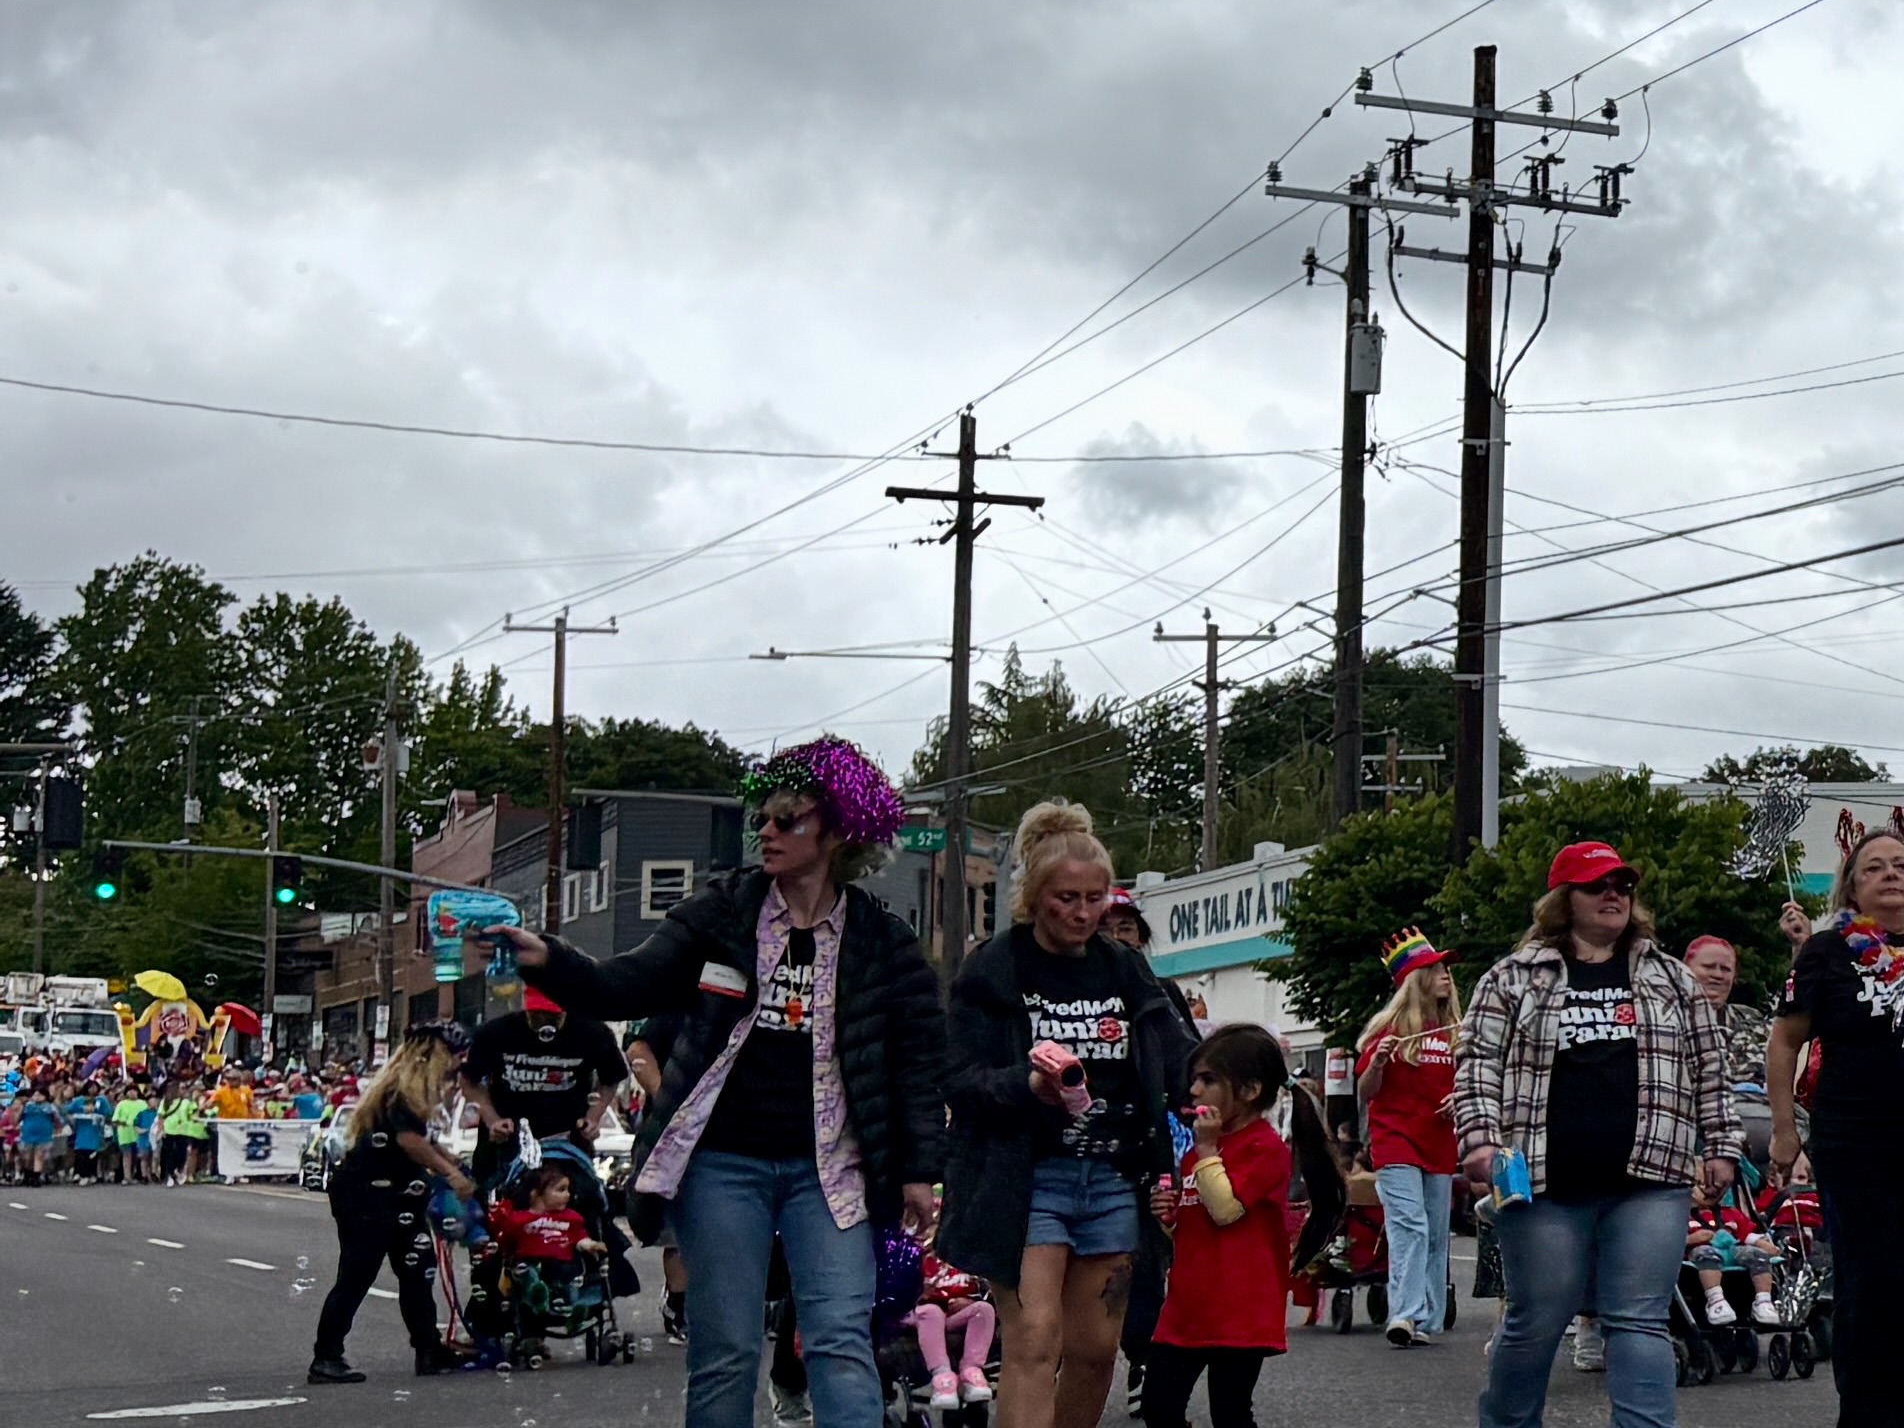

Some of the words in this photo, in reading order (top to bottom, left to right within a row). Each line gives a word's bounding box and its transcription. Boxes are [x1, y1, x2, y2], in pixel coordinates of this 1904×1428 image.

[1170, 900, 1199, 944] ONE
[1203, 892, 1232, 937] TAIL
[1234, 887, 1253, 930] AT
[1256, 883, 1268, 926] A
